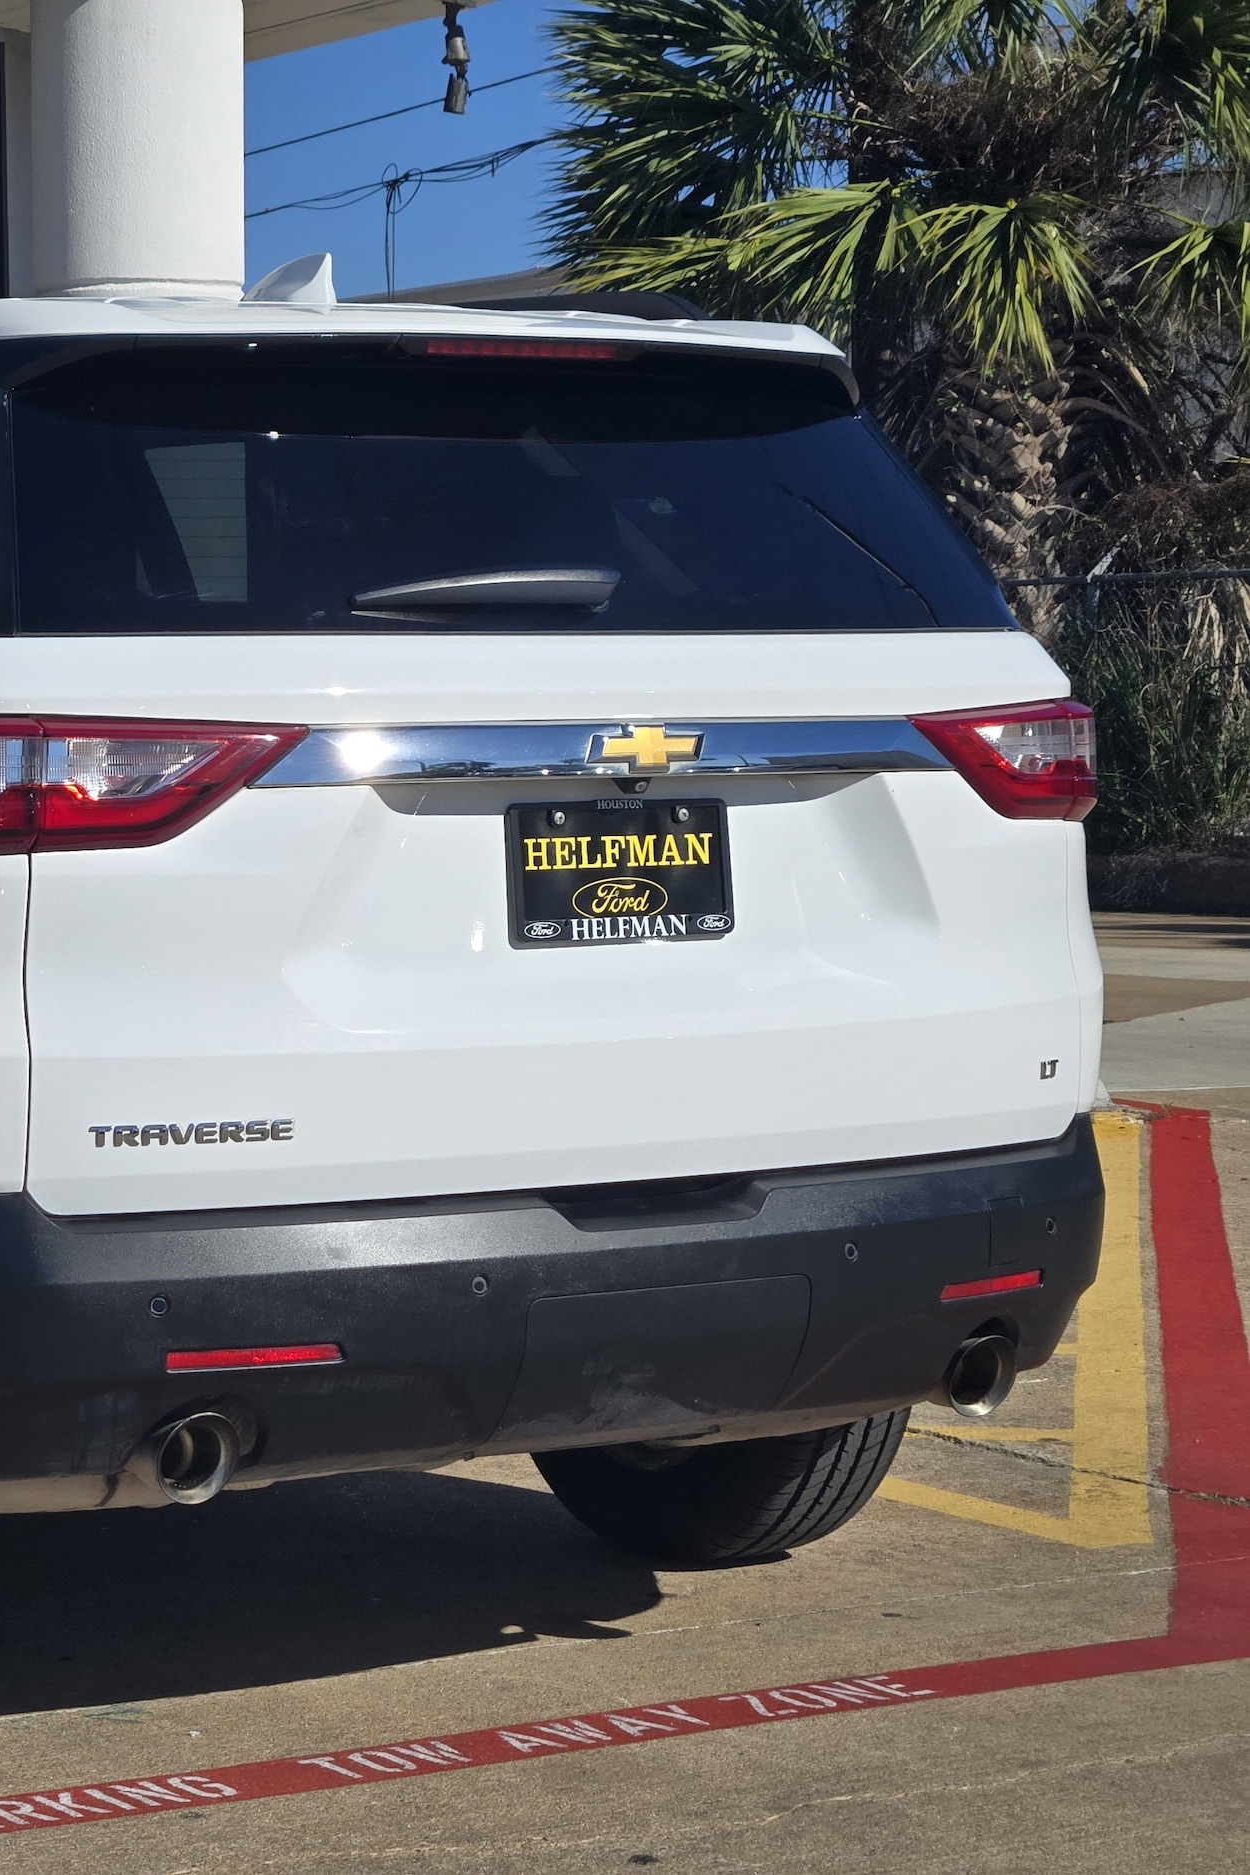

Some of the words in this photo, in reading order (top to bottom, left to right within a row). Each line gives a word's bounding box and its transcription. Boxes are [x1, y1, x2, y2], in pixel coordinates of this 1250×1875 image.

[597, 799, 643, 810] HOUSTON
[523, 833, 713, 871] HELFMAN
[591, 883, 649, 914] Ford
[530, 923, 555, 937] Ford
[570, 914, 688, 941] HELFMAN
[702, 916, 726, 929] Ford
[1040, 1059, 1059, 1080] LT
[88, 1118, 295, 1148] TRAVERSE
[297, 1740, 473, 1778] TOW
[496, 1704, 710, 1753] AWAY
[718, 1675, 935, 1717] ZONE
